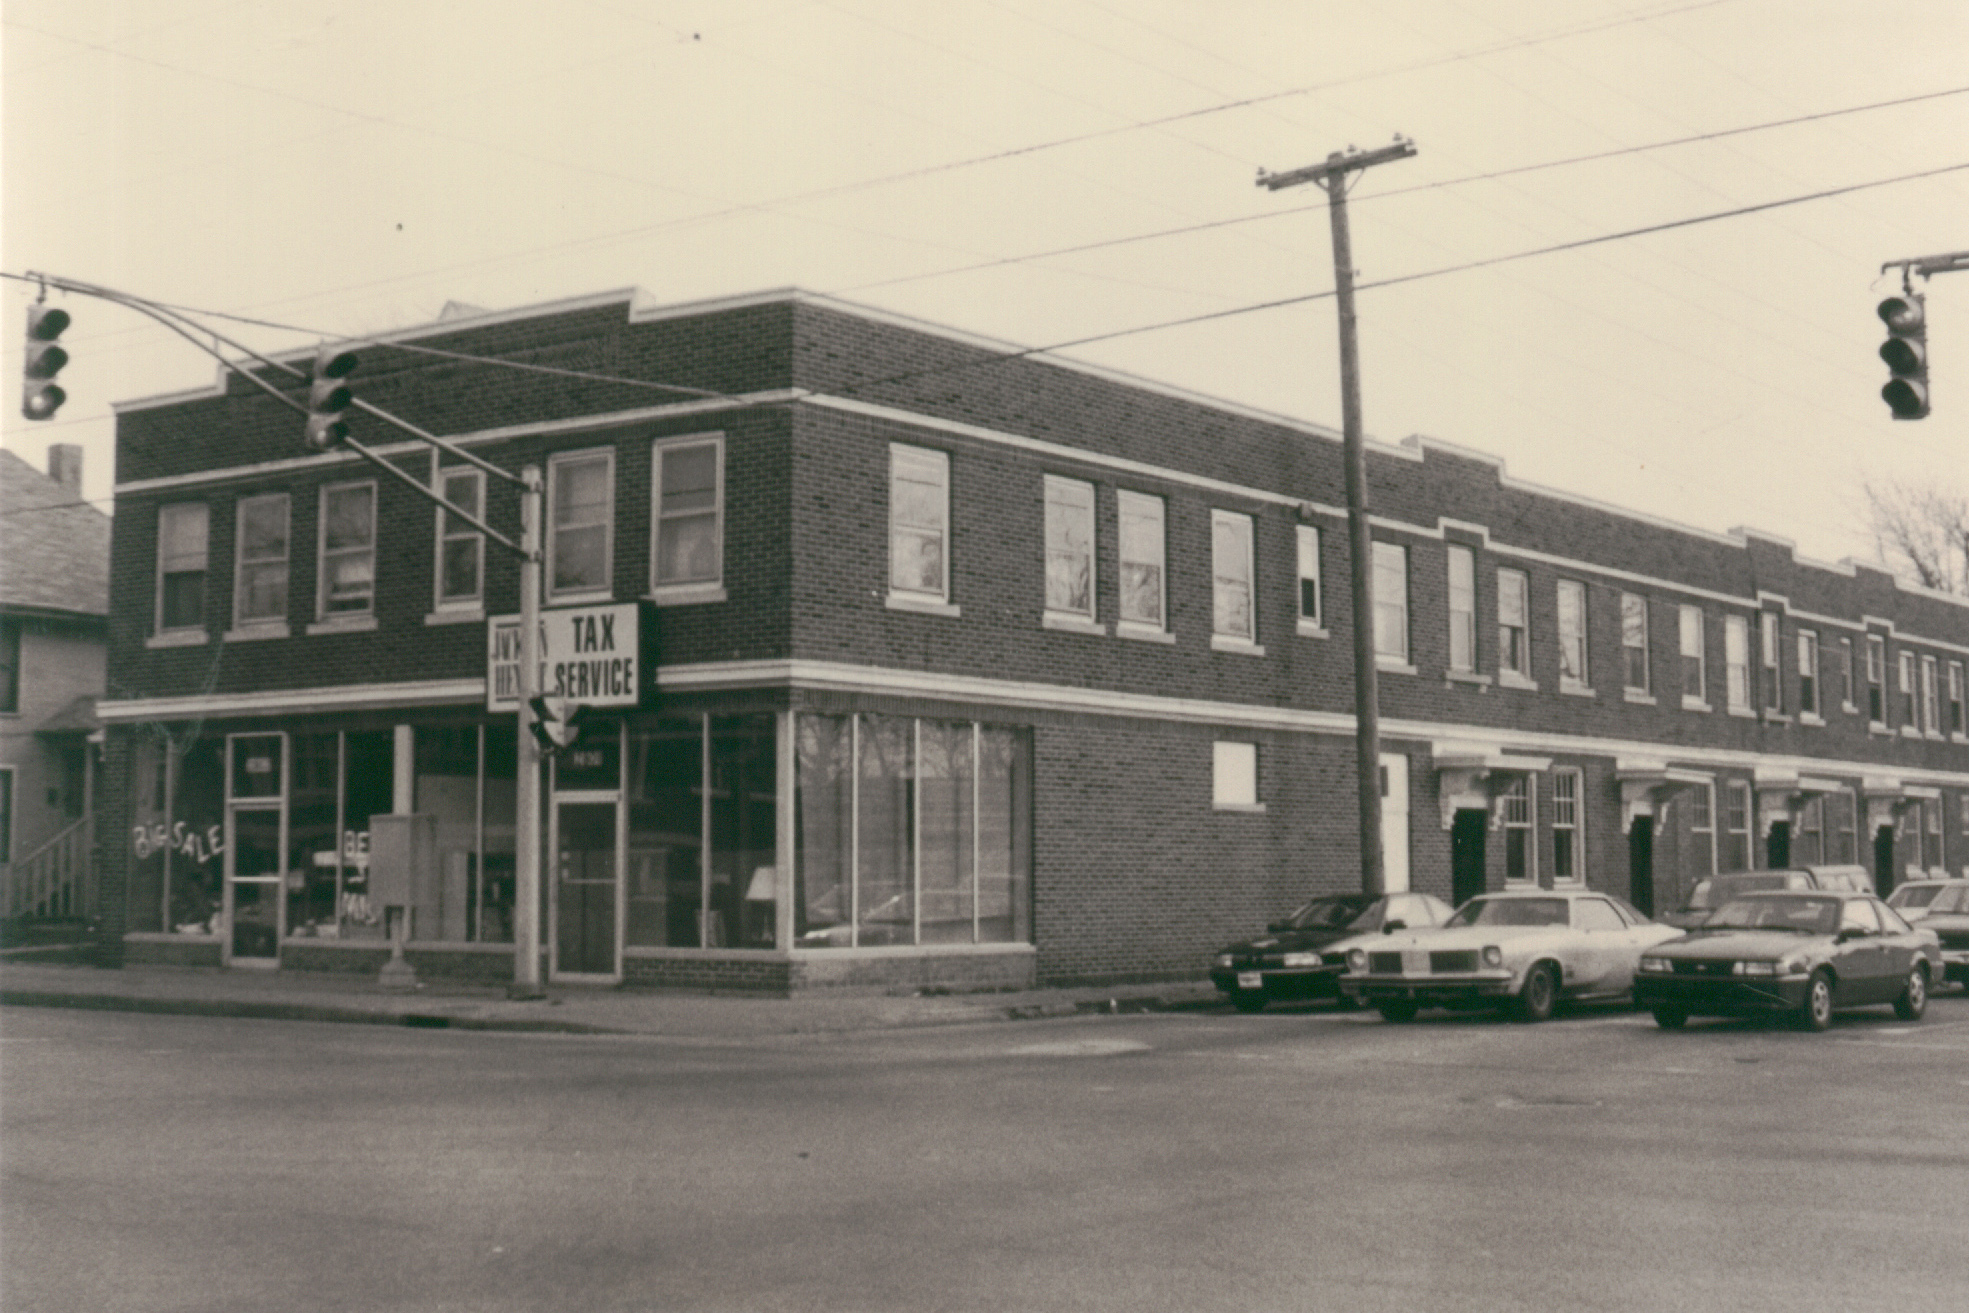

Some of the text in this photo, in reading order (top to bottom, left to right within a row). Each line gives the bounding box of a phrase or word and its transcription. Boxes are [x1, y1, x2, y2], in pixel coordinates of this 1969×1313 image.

[572, 613, 615, 653] TAX
[555, 657, 633, 698] SERVICE
[170, 821, 226, 864] SALE
